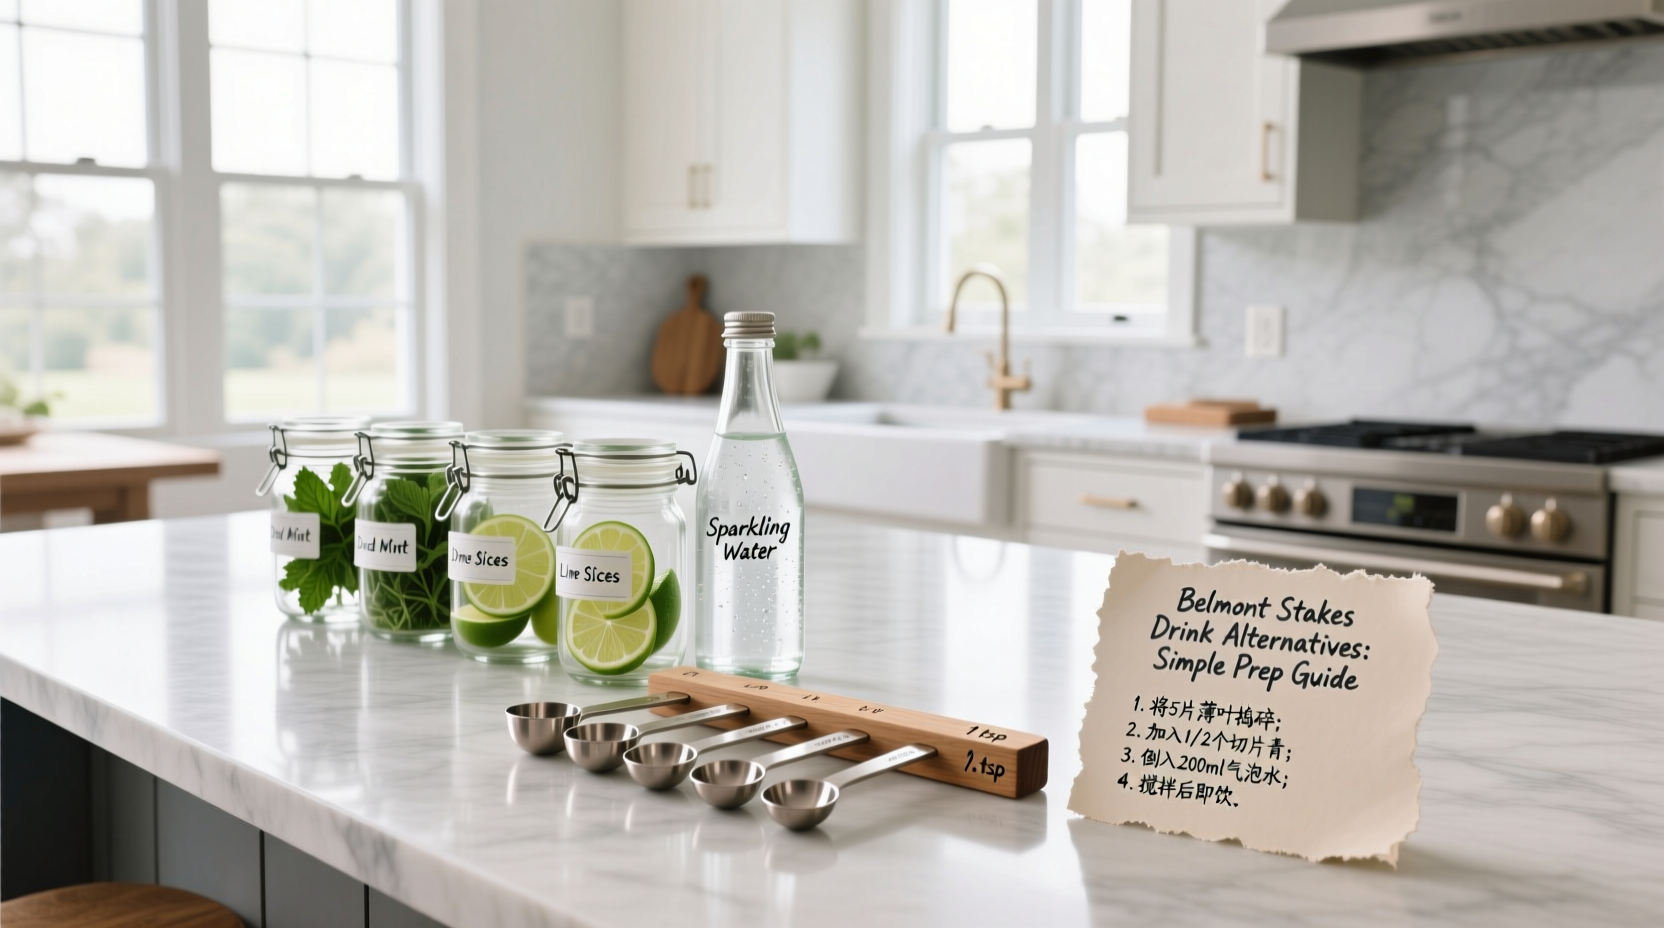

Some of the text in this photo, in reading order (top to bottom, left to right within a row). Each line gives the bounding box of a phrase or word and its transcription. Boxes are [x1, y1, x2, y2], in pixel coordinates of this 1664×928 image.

[706, 515, 791, 546] Sparkling
[723, 541, 778, 561] Water
[1176, 586, 1355, 628] Belmont Stakes
[1150, 614, 1371, 661] Drink Alternatives:
[1153, 645, 1360, 693] Simple Prep Guide
[1133, 694, 1145, 713] 1.
[1125, 721, 1141, 739] 2.
[1120, 746, 1135, 764] 3.
[1117, 772, 1133, 791] 4.
